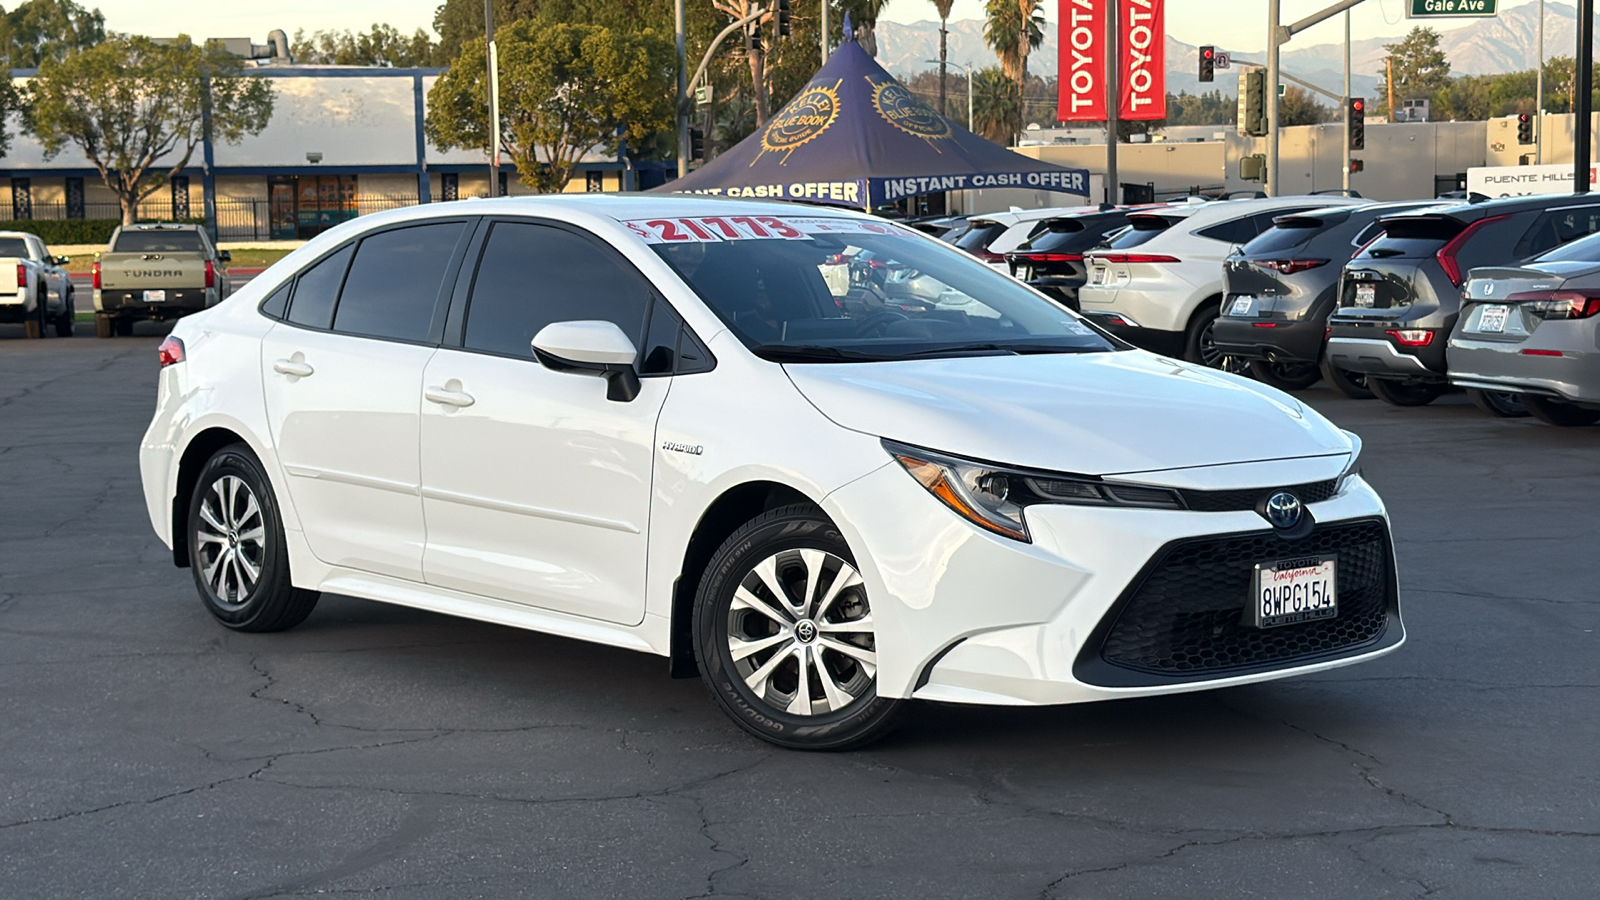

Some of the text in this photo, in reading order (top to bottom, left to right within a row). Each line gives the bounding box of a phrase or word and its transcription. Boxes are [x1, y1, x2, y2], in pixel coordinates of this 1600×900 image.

[1424, 0, 1485, 11] Gale Ave
[789, 94, 831, 114] KELLEY
[796, 115, 828, 126] BOOK
[886, 107, 911, 120] BLUE
[884, 172, 1083, 199] INSTANT CASH OFFER
[1485, 175, 1537, 184] PUENTE
[727, 184, 784, 198] CASH
[789, 182, 859, 202] OFFER
[735, 541, 752, 557] 91H
[1277, 558, 1318, 568] TOYOTA
[1273, 567, 1321, 584] California
[1263, 580, 1331, 616] 8WPG154
